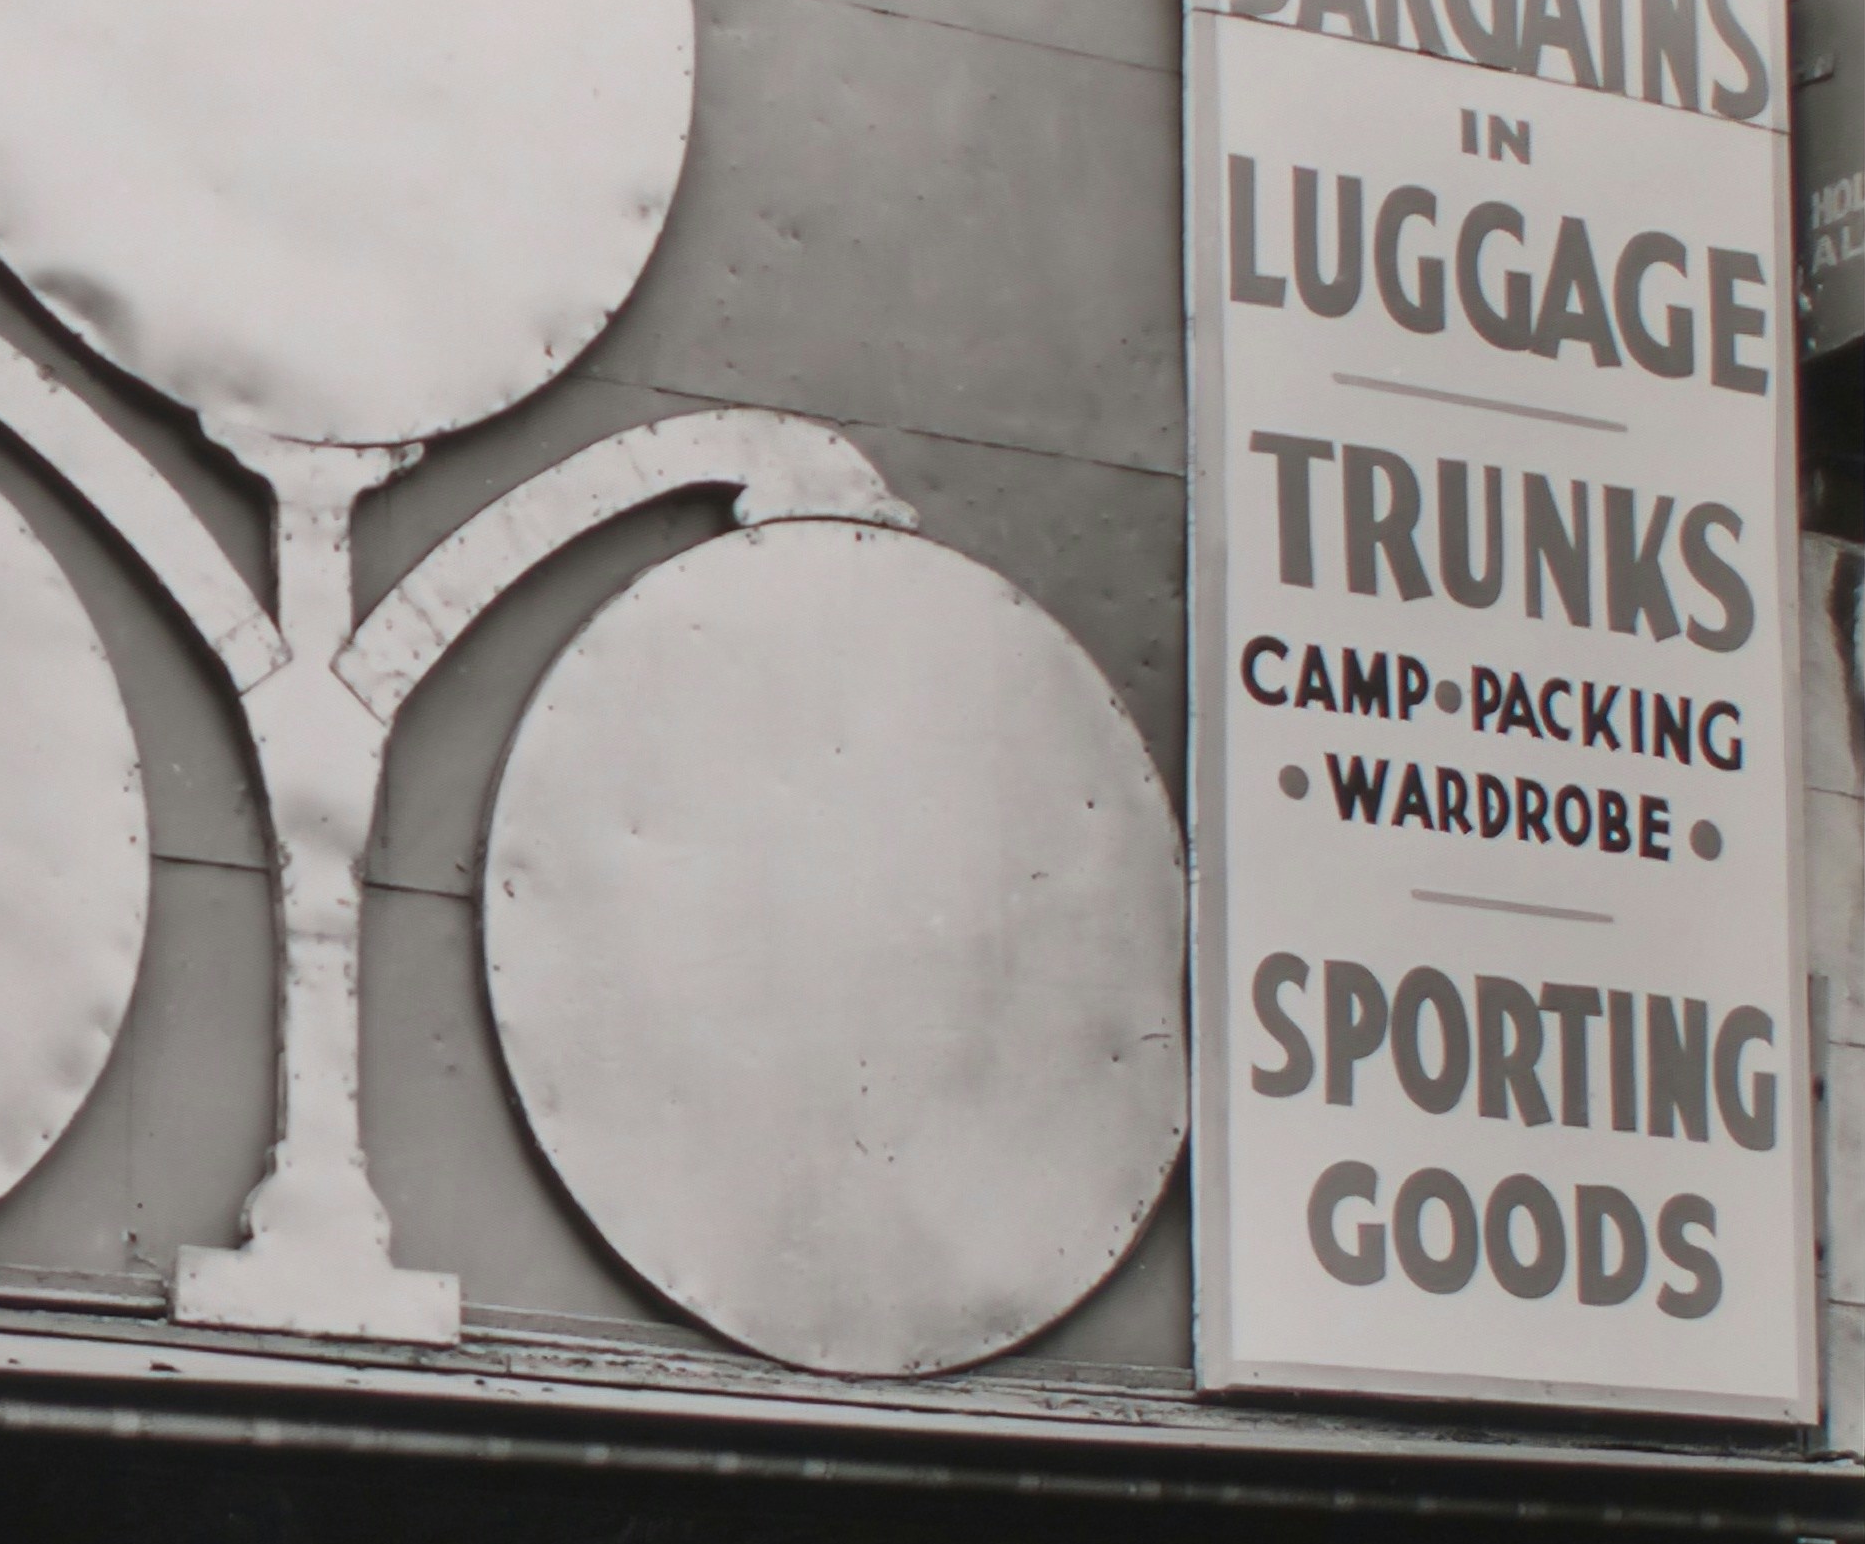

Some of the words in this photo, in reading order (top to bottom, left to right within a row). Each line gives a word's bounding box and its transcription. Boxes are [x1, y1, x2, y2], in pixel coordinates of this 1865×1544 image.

[1462, 109, 1530, 164] IN
[1230, 155, 1768, 396] LUGGAGE
[1251, 432, 1754, 653] TRUNKS
[1326, 754, 1670, 861] WARDROBE
[1253, 953, 1776, 1151] SPORTING
[1308, 1161, 1722, 1319] GOODS
